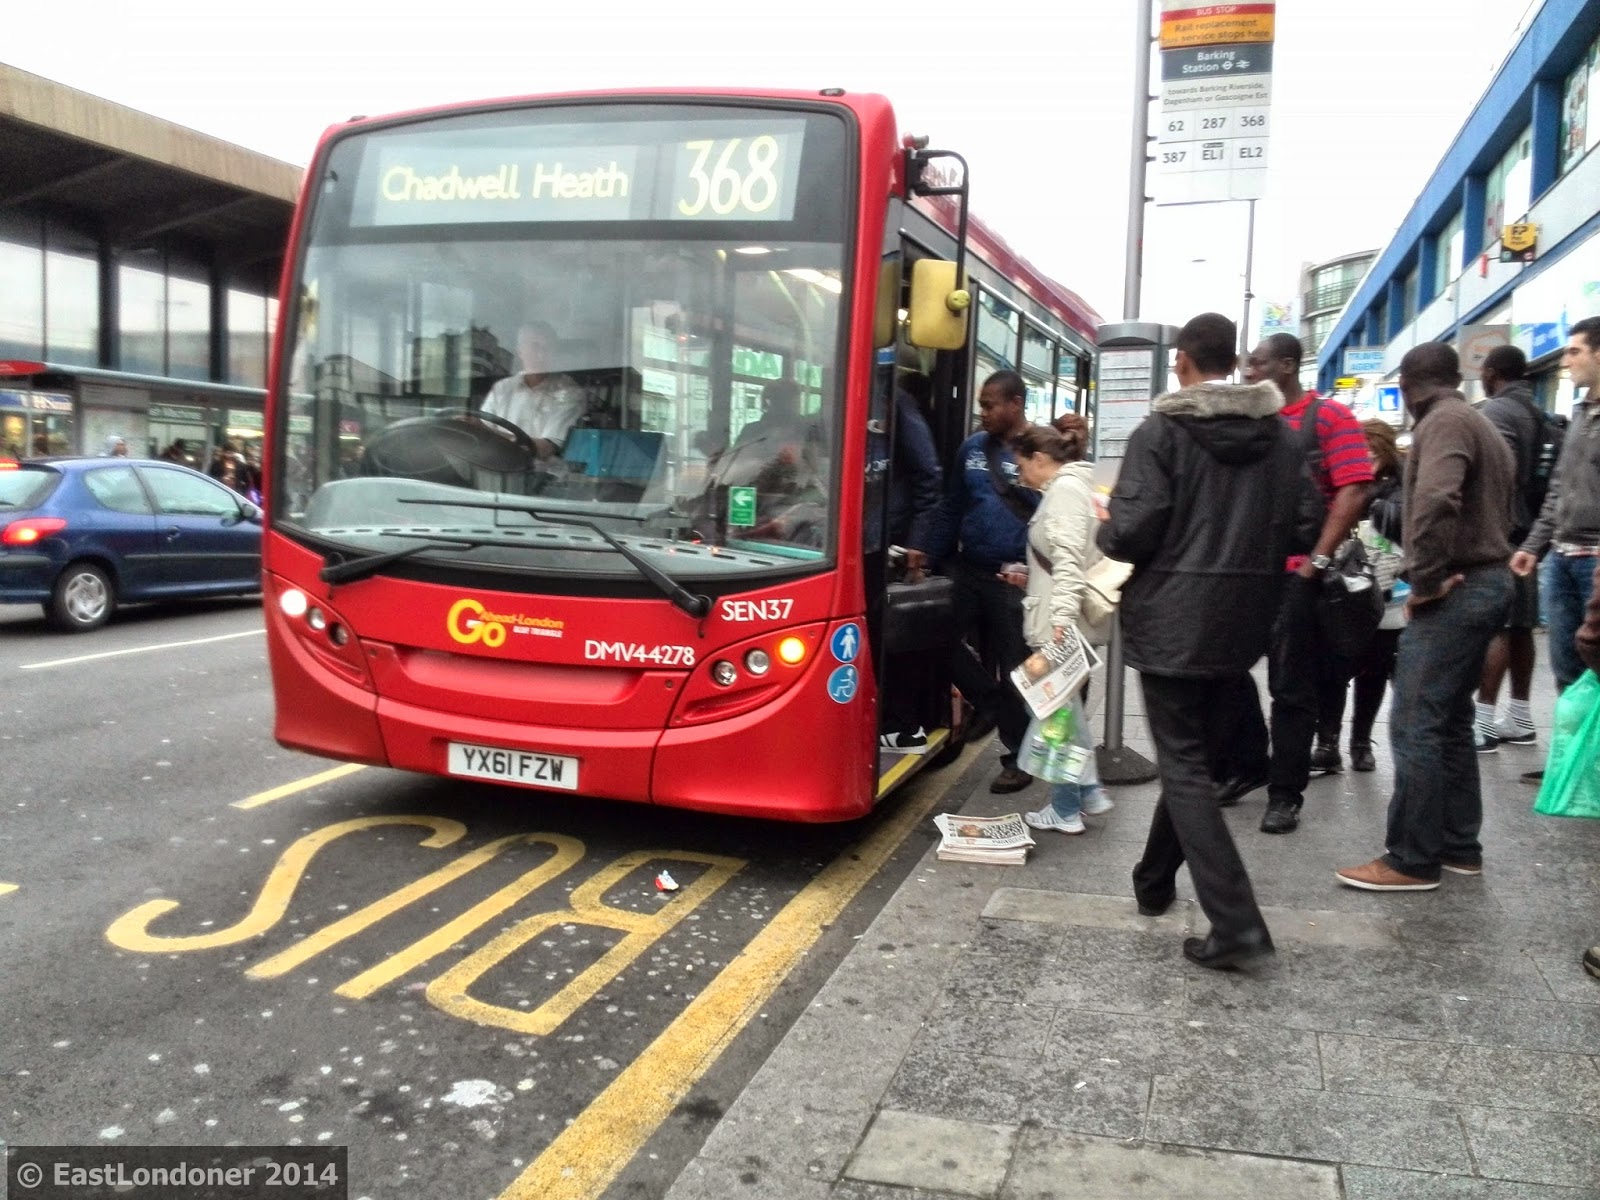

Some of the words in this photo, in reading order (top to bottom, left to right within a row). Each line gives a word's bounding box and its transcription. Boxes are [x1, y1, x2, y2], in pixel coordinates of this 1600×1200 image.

[1196, 7, 1212, 16] BUS
[1215, 6, 1237, 14] STOP
[1175, 23, 1193, 32] Rail
[1195, 19, 1257, 30] replacement
[1181, 32, 1215, 41] service
[1218, 30, 1245, 40] stops
[1247, 29, 1270, 38] here
[1197, 51, 1236, 61] Barking
[1182, 63, 1219, 73] Station
[1168, 87, 1198, 95] towards
[1200, 85, 1227, 93] Barking
[1163, 97, 1203, 105] Dagenham
[1215, 93, 1253, 102] Gascoigne
[1168, 120, 1184, 132] 62
[1202, 117, 1227, 129] 287
[1240, 115, 1265, 127] 368
[1162, 151, 1187, 163] 387
[1202, 149, 1224, 161] EL1
[1240, 147, 1263, 159] EL2
[381, 164, 520, 201] Chadwell
[532, 160, 629, 199] Heath
[677, 135, 779, 217] 368
[720, 598, 794, 622] SEN37
[447, 599, 506, 648] Go
[584, 640, 695, 667] DMV44278
[463, 747, 512, 775] YX61
[519, 754, 563, 782] FZW
[105, 815, 748, 1036] BUS
